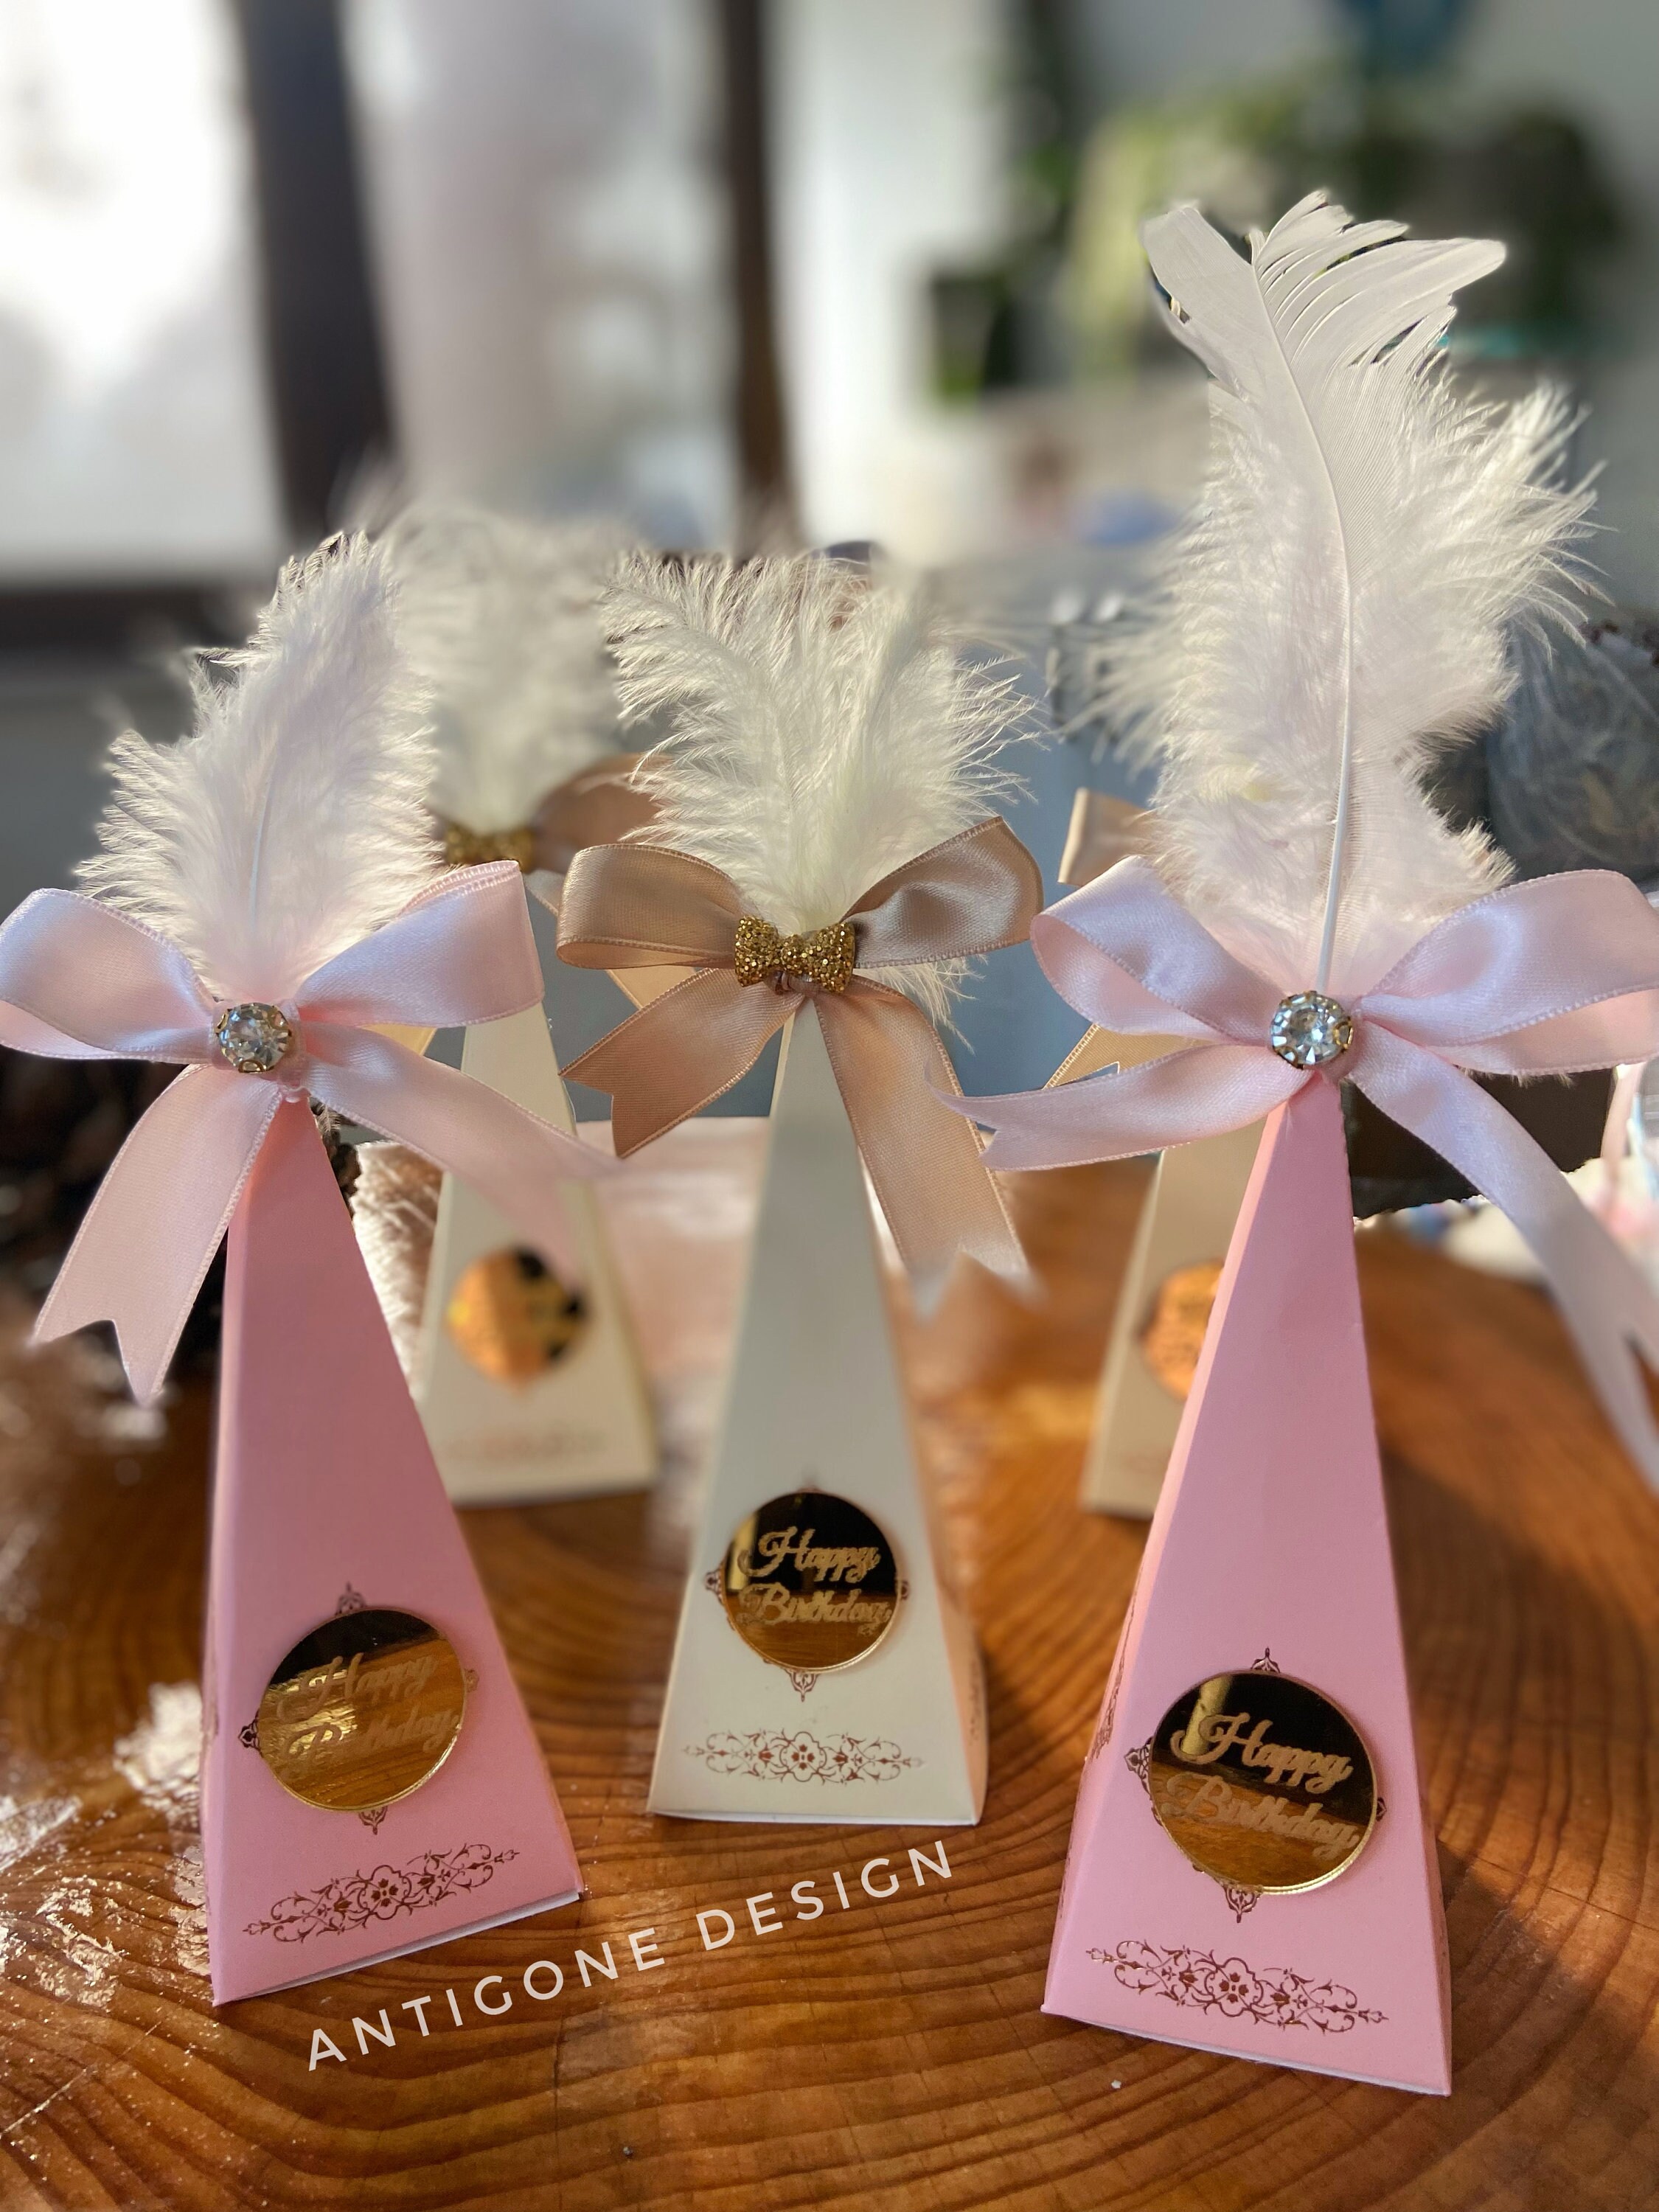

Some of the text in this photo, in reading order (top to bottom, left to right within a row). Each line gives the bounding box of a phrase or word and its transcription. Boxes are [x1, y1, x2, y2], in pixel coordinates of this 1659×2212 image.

[738, 1526, 881, 1583] Happy
[739, 1582, 892, 1636] Birthday
[276, 1652, 439, 1722] Happy
[1170, 1712, 1354, 1793] Happy
[1161, 1772, 1360, 1860] Birthday
